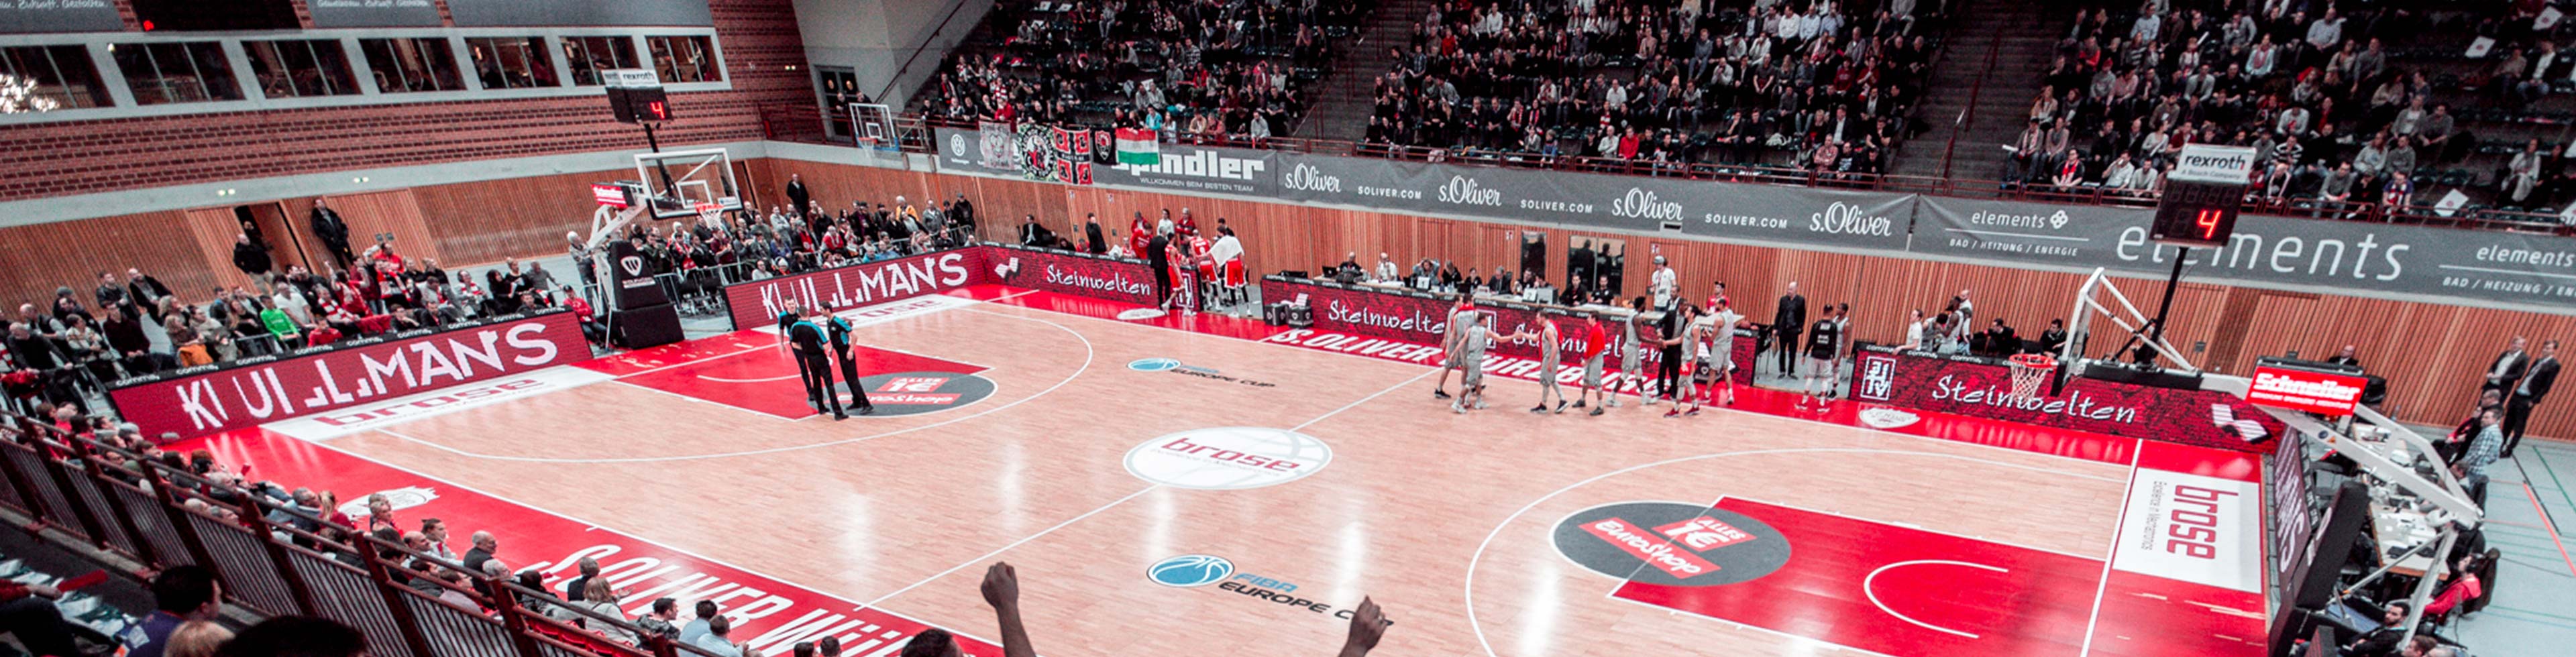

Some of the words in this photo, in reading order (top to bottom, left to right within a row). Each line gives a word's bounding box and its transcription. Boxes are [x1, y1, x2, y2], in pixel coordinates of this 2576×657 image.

[650, 101, 665, 120] 4
[2185, 155, 2246, 170] rexroth
[1140, 178, 1185, 186] WILLKOMMEN
[1186, 180, 1203, 188] BEIM
[1205, 182, 1232, 190] BESTEN
[1285, 162, 1341, 194] s.Oliver
[1358, 185, 1421, 200] SOLIVER.COM
[1438, 174, 1502, 206] s.Oliver
[1520, 198, 1593, 214] SOLIVER.COM
[1611, 187, 1683, 221] s.Oliver
[1809, 201, 1892, 237] s.Oliver
[1705, 213, 1788, 229] SOLIVER.COM
[1972, 210, 2045, 229] elements
[2196, 209, 2222, 240] 4
[1949, 239, 1969, 248] BAD
[1980, 241, 2023, 253] HEIZUNG
[2035, 245, 2078, 257] ENERGIE
[2476, 245, 2575, 267] elements
[1046, 264, 1150, 296] Steinwelten
[2443, 277, 2469, 287] BAD
[2483, 280, 2542, 294] HEIZUNG
[1270, 328, 1443, 363] S.OLIVER
[313, 379, 543, 426] brose
[1932, 373, 2135, 424] Steinwelten
[1161, 437, 1300, 472] brose
[1664, 520, 1731, 549] 1€
[1697, 519, 1746, 539] ALLES
[2166, 484, 2239, 560] brose
[1595, 520, 1702, 574] EuroShop
[1218, 581, 1332, 613] EUROPE
[1232, 573, 1298, 593] FIBA
